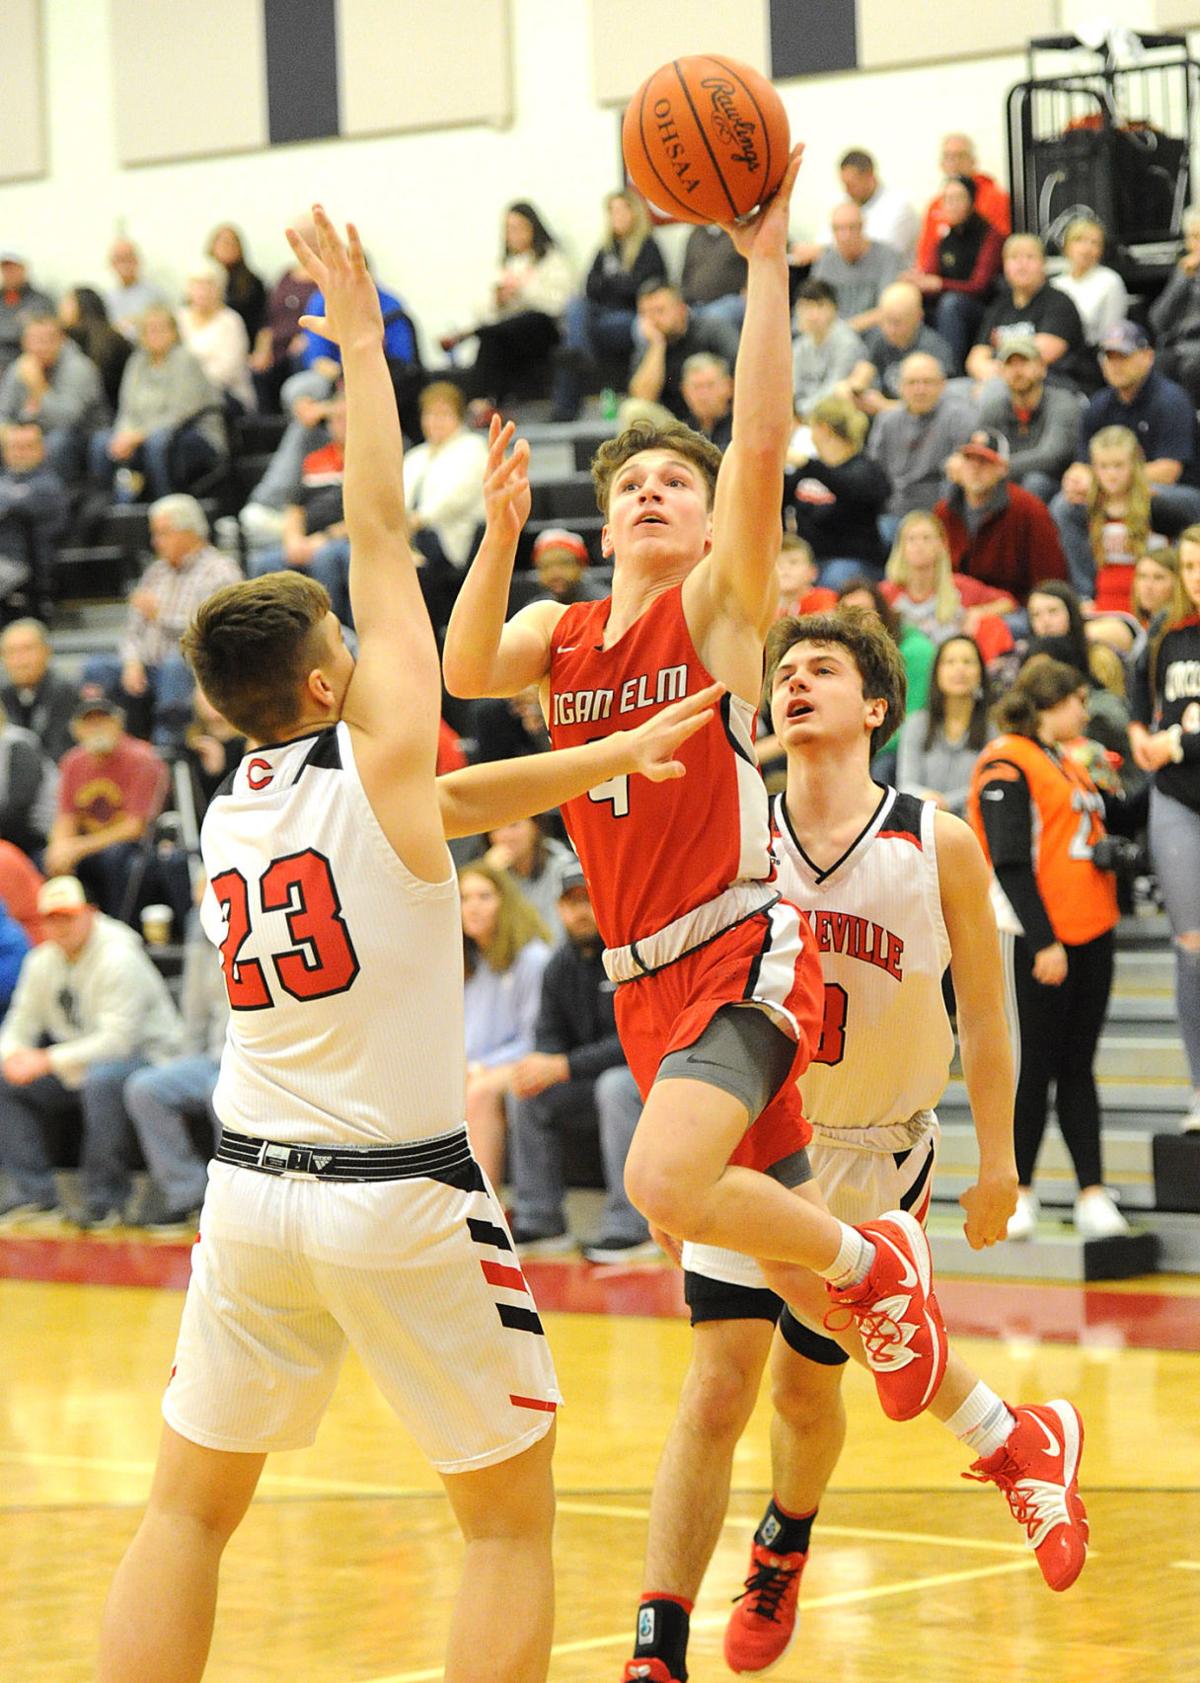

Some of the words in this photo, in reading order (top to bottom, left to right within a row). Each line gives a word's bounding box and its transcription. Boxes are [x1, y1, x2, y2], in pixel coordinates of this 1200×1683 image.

[654, 99, 700, 193] OHSAA
[701, 77, 759, 172] Rawlings
[618, 664, 688, 714] ELM
[247, 758, 273, 790] C
[210, 847, 361, 1011] 23
